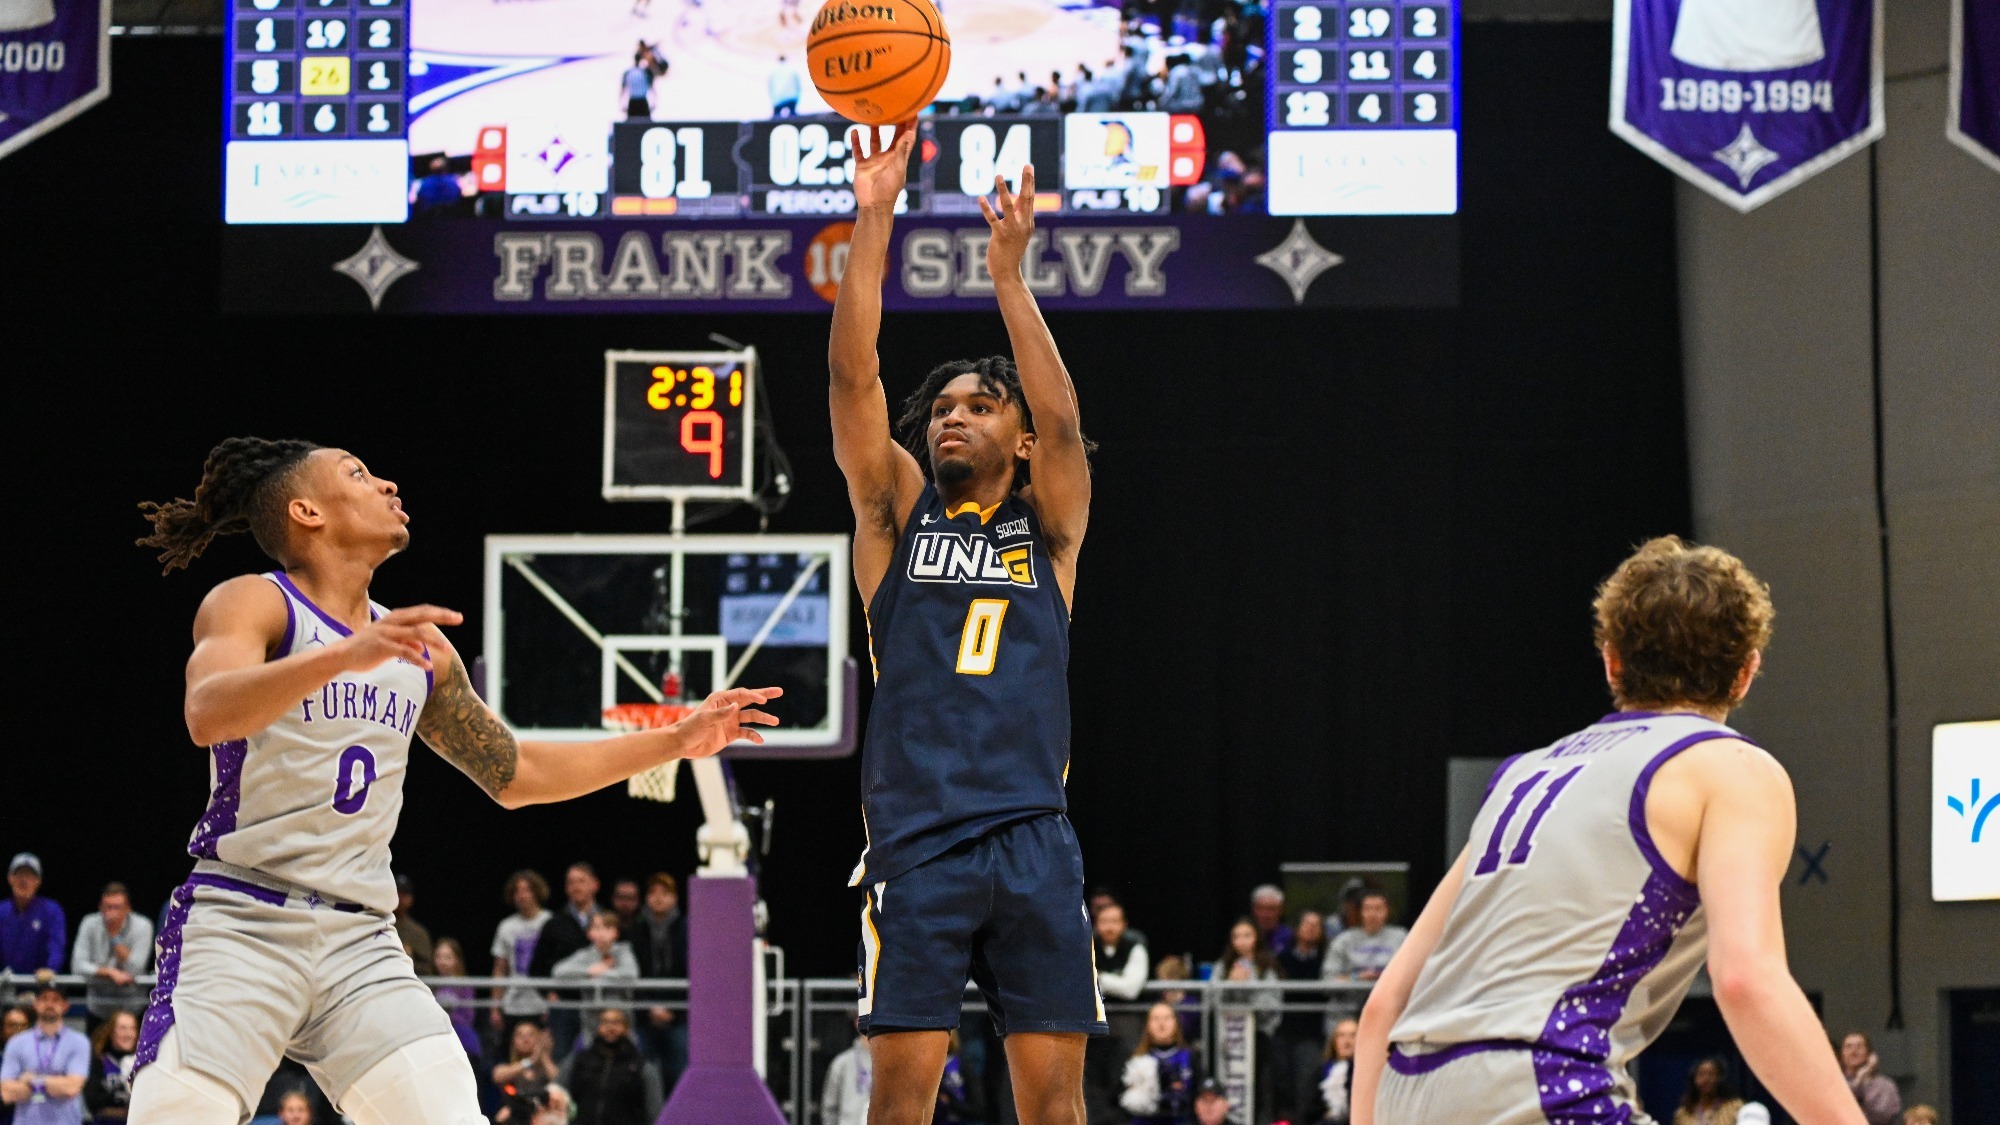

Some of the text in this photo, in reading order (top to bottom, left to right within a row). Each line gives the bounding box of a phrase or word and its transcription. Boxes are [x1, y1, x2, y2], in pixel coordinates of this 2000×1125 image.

[255, 17, 391, 52] 1 19 2
[811, 1, 896, 36] Wilson
[1293, 5, 1437, 41] 2 19 2
[0, 40, 66, 73] 000
[1293, 48, 1437, 84] 3 11 4
[251, 59, 391, 94] 5 26 1
[246, 101, 390, 136] 11 6 1
[1286, 90, 1437, 127] 12 4 3
[640, 126, 712, 200] 81
[959, 123, 1032, 197] 84
[562, 190, 599, 217] 10
[765, 189, 857, 215] PERIOD
[1123, 186, 1161, 212] 10
[494, 229, 792, 300] FRANK
[902, 227, 1181, 298] SELVY
[646, 365, 743, 411] 2:31
[680, 410, 723, 479] 9
[996, 517, 1031, 540] SOCON
[907, 532, 1038, 589] UNCG
[955, 598, 1010, 676] 0
[301, 681, 417, 738] FURMAN
[331, 742, 379, 816] 0
[1472, 763, 1586, 878] 11
